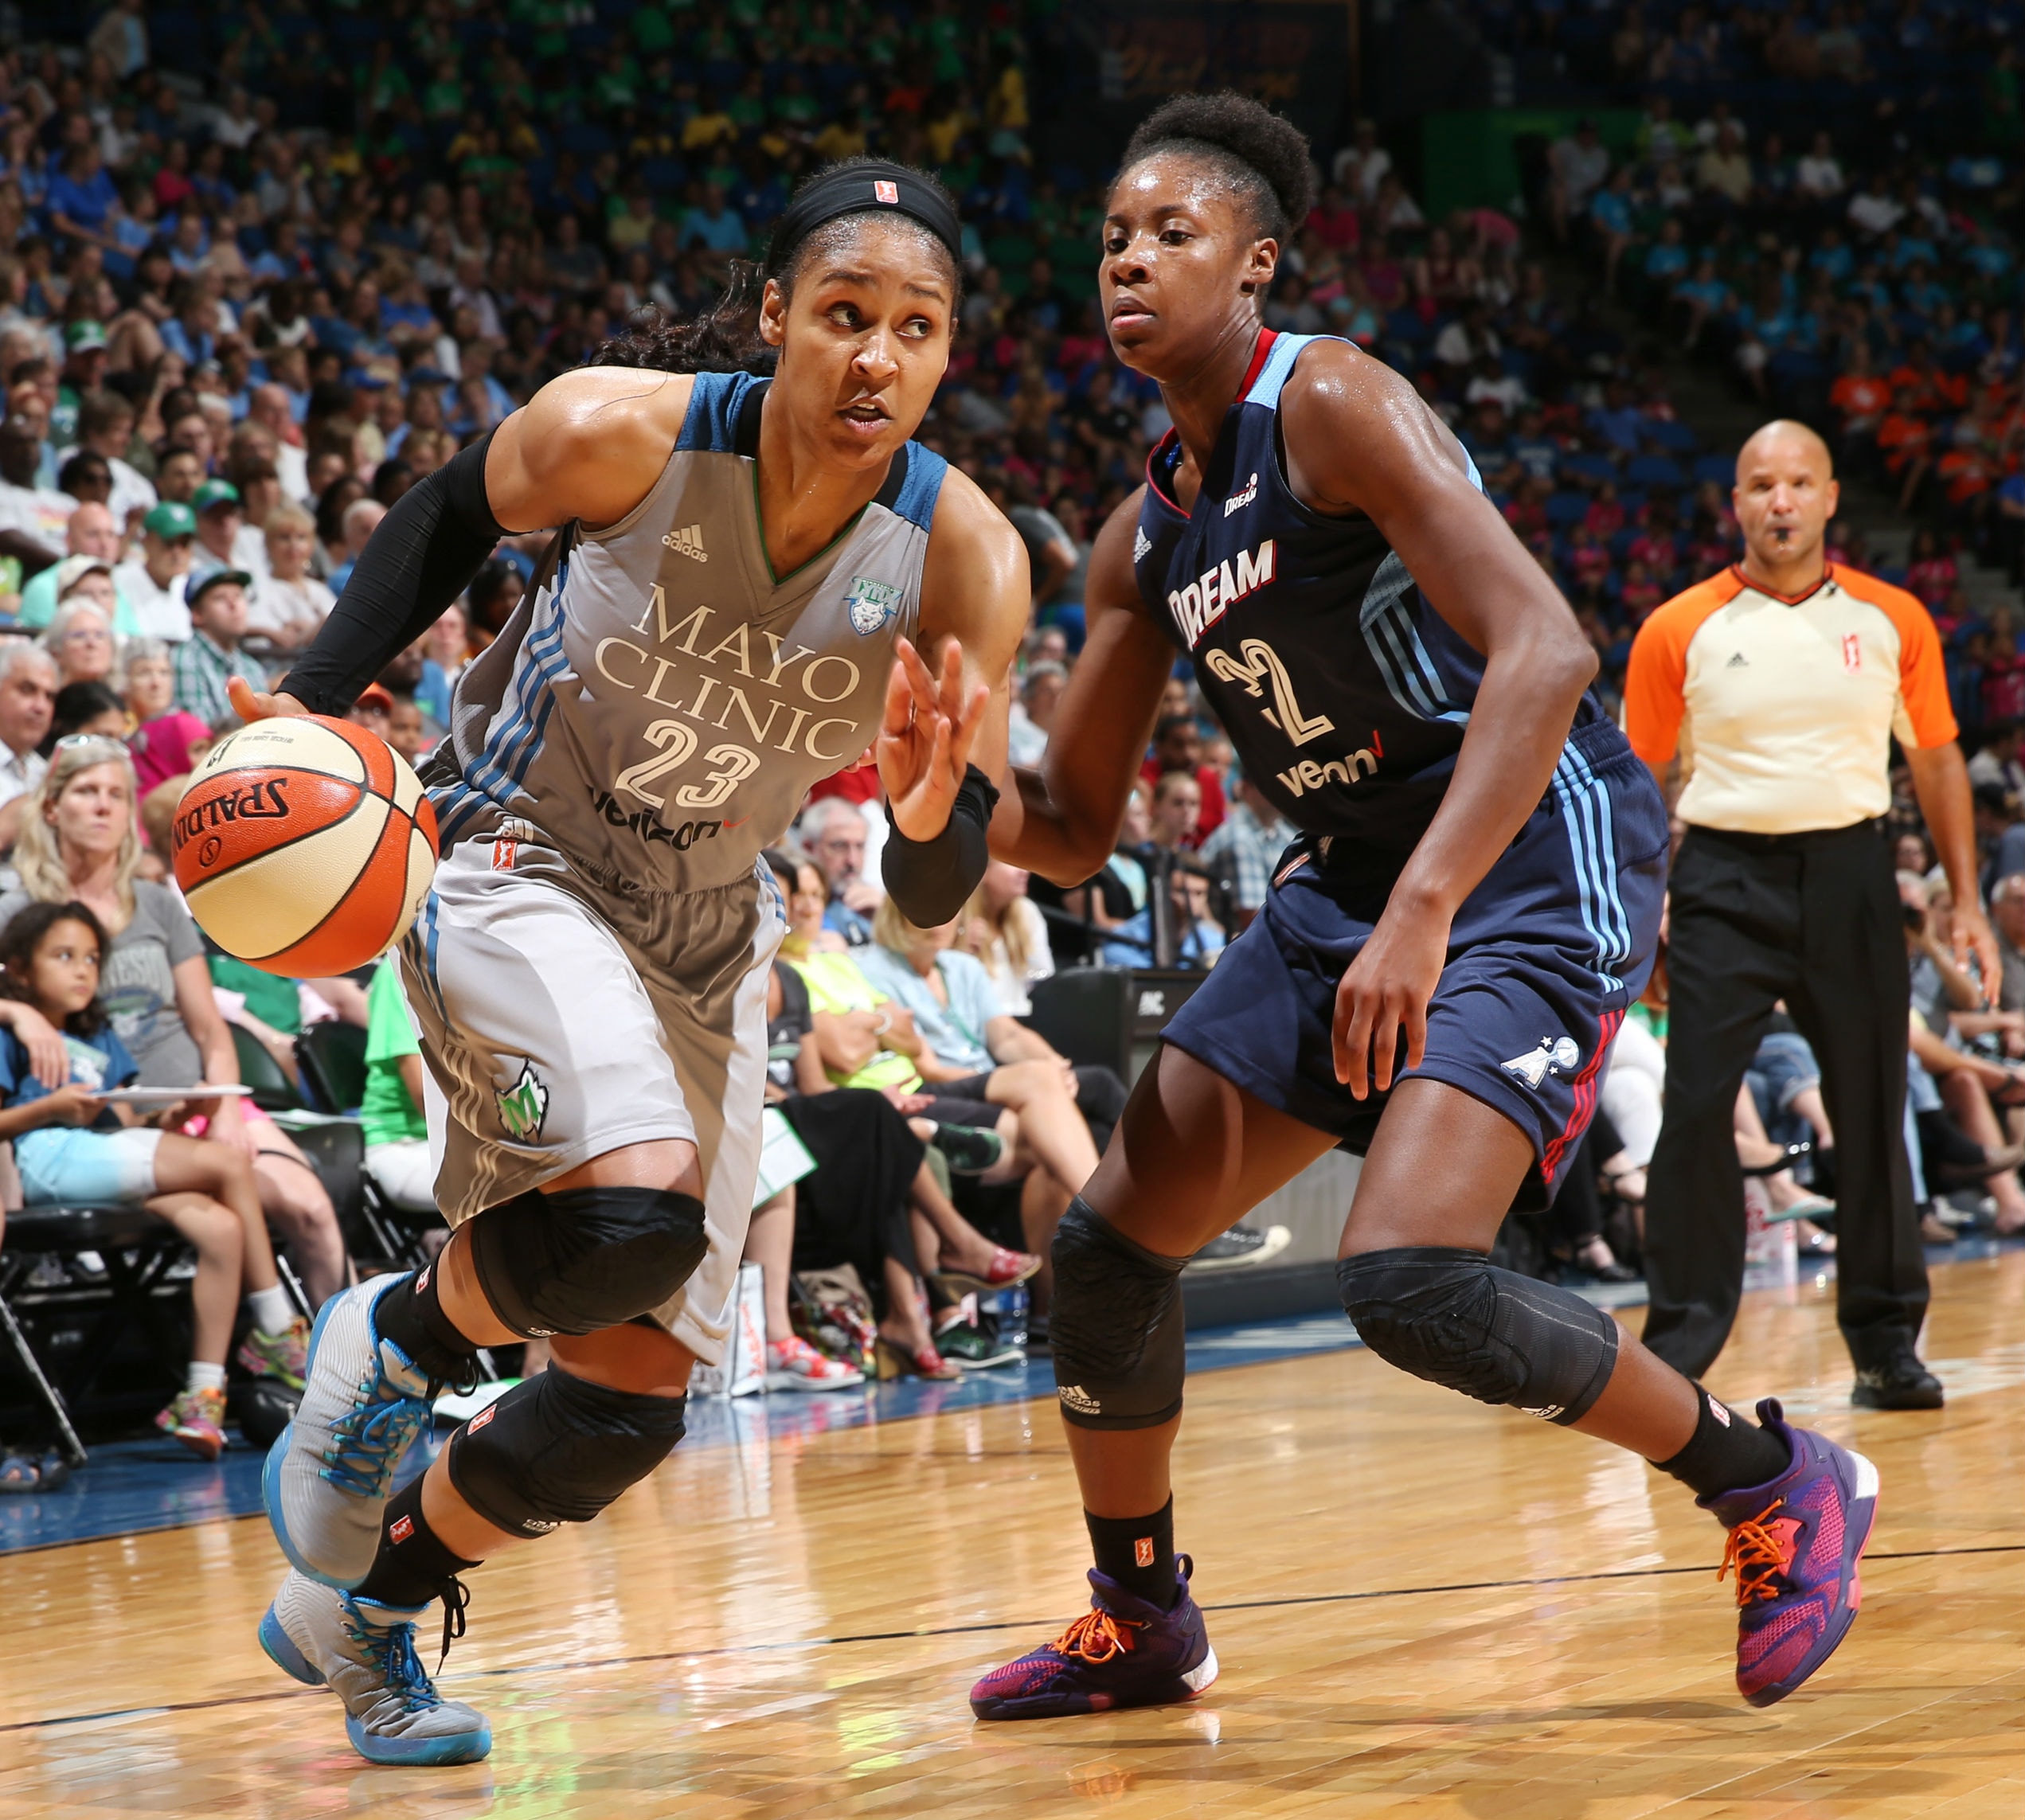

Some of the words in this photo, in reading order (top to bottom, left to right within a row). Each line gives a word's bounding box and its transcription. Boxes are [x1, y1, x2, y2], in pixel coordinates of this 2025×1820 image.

[1224, 487, 1257, 517] DREAM
[662, 535, 709, 563] adidas
[1167, 538, 1276, 653] DREAM
[631, 582, 861, 704] MAYO
[594, 637, 858, 761] CLINIC
[614, 719, 761, 810] 23
[172, 777, 288, 858] SPALDIN
